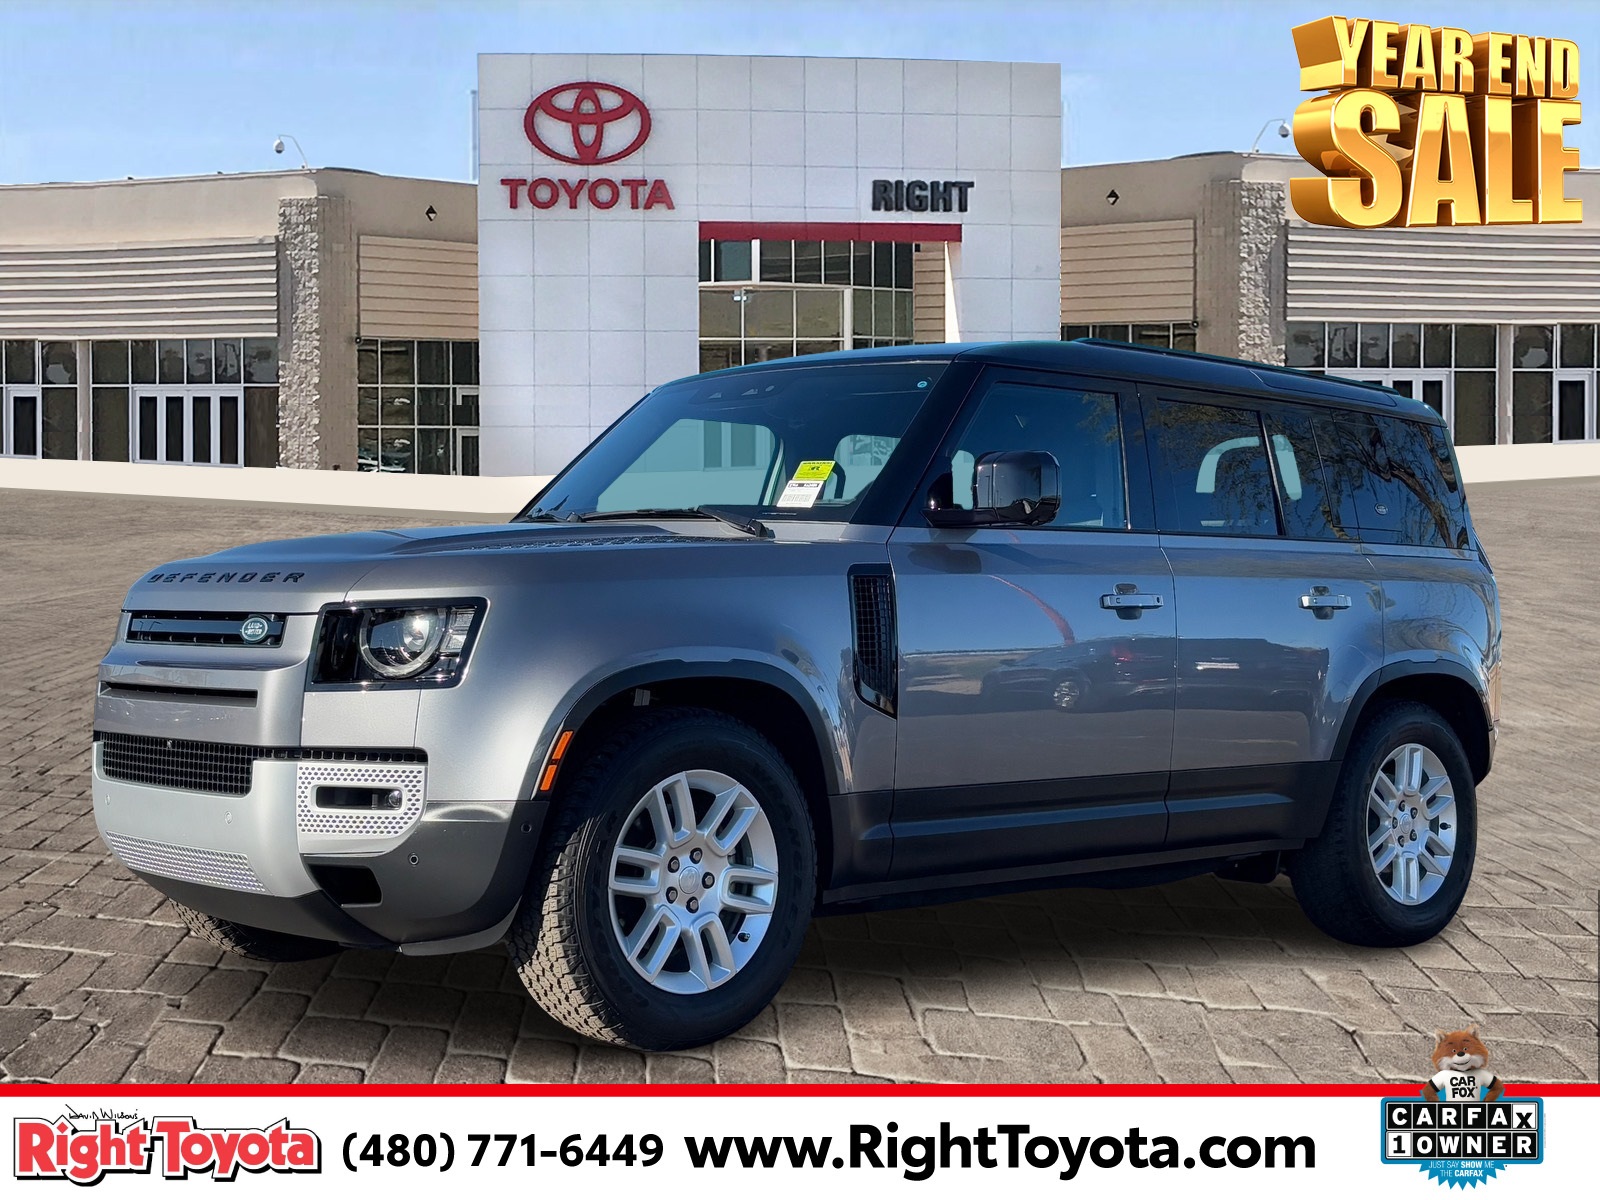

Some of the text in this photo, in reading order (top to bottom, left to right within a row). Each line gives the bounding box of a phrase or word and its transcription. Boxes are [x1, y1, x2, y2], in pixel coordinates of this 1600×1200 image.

[500, 178, 675, 210] TOYOTA
[871, 179, 975, 212] RIGHT
[147, 572, 305, 583] DEFENDER
